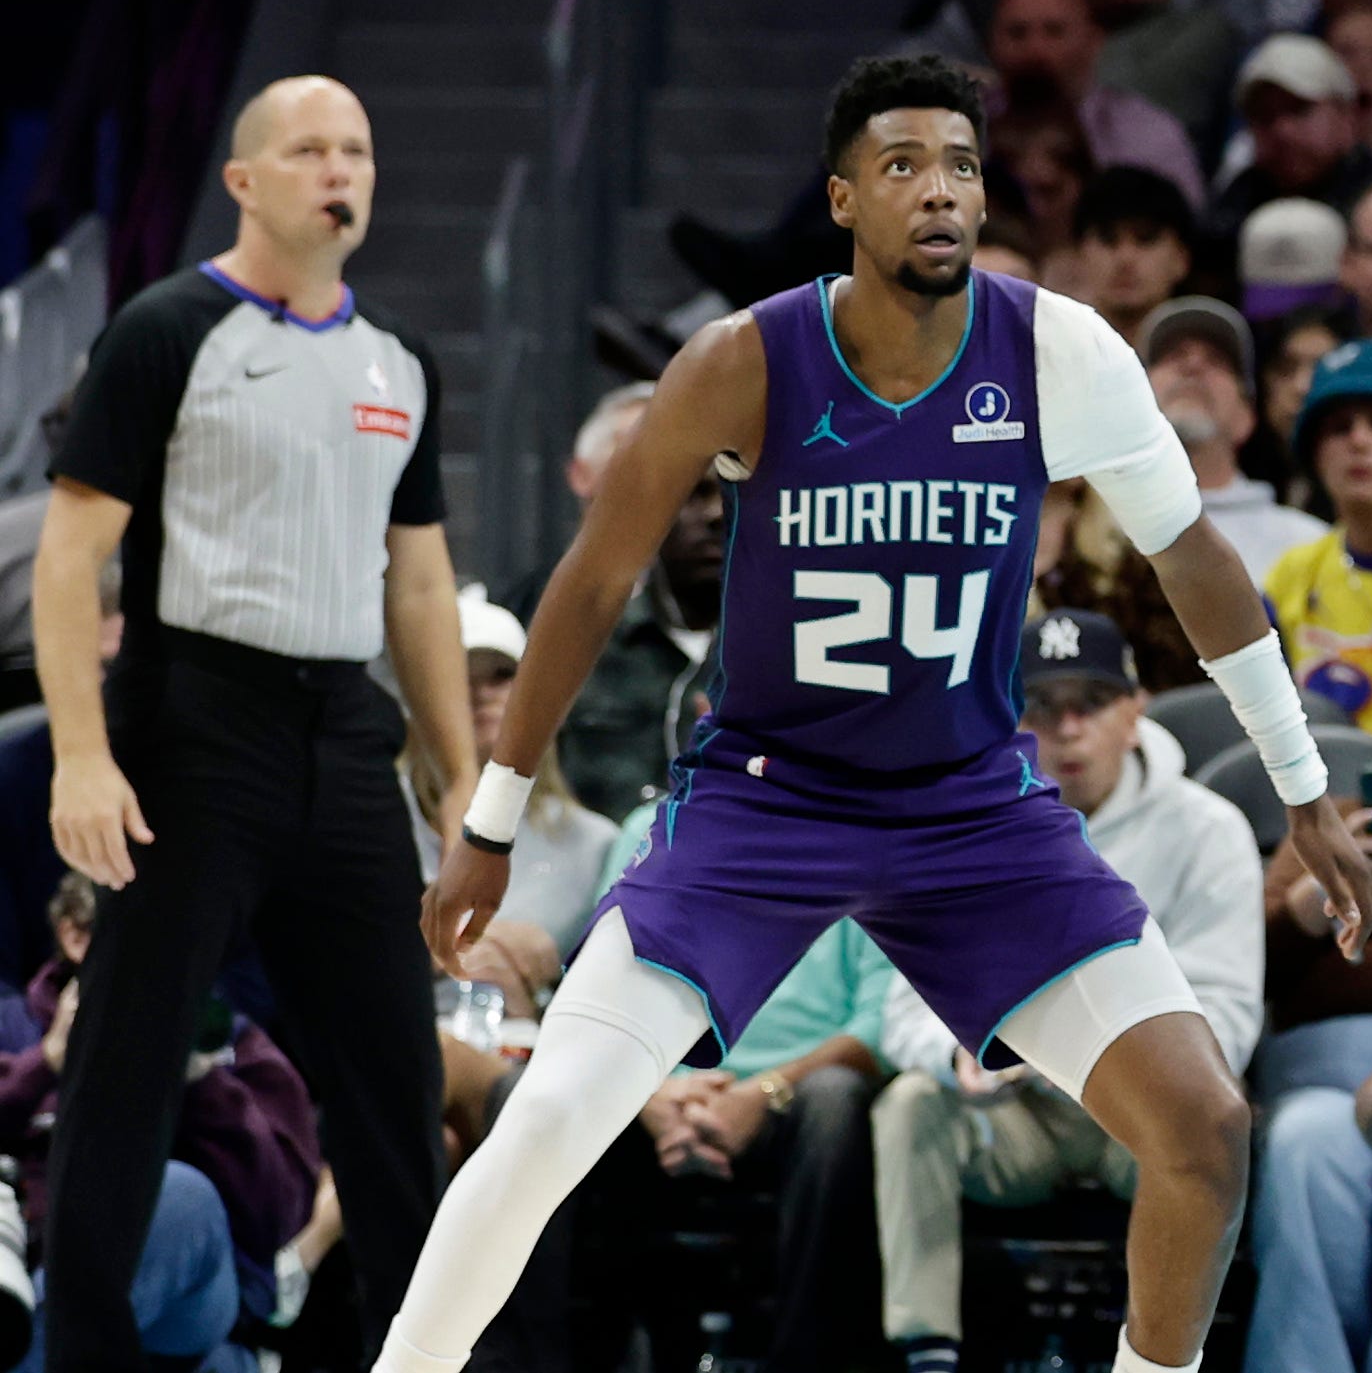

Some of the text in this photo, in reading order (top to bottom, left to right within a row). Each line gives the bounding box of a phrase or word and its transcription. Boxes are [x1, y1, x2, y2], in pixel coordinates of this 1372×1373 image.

[986, 425, 1023, 438] Health
[772, 479, 1018, 547] HORNETS
[793, 569, 992, 695] 24
